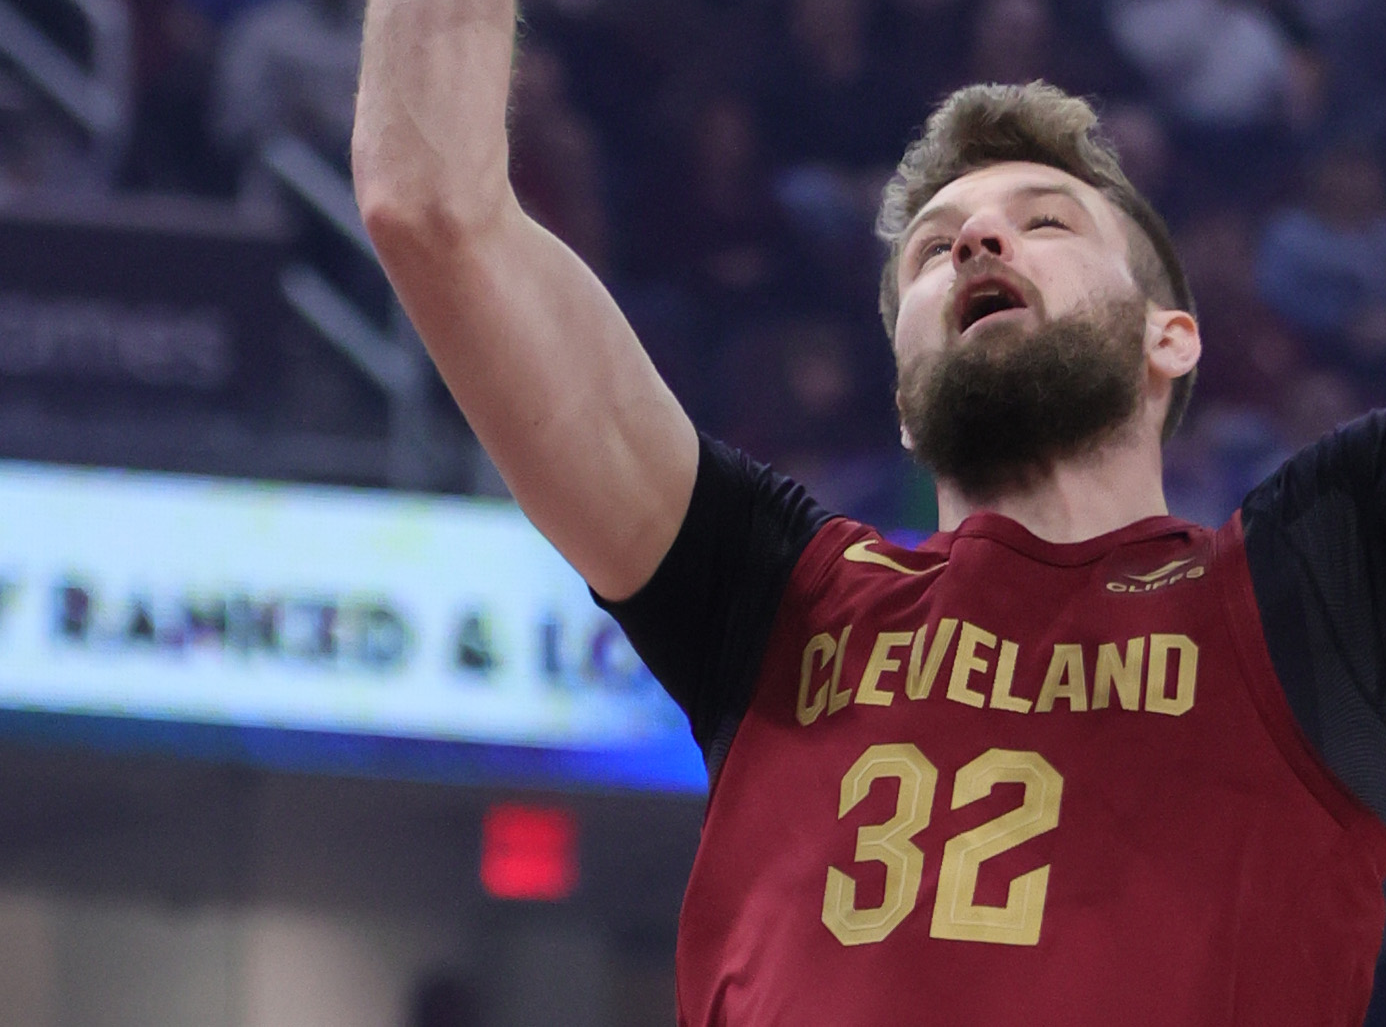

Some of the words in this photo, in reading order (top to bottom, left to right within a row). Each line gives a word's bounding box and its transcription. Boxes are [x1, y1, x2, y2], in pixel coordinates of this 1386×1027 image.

[1106, 566, 1204, 592] CLIFFS
[796, 618, 1198, 726] CLEVELAND
[821, 743, 1064, 946] 32
